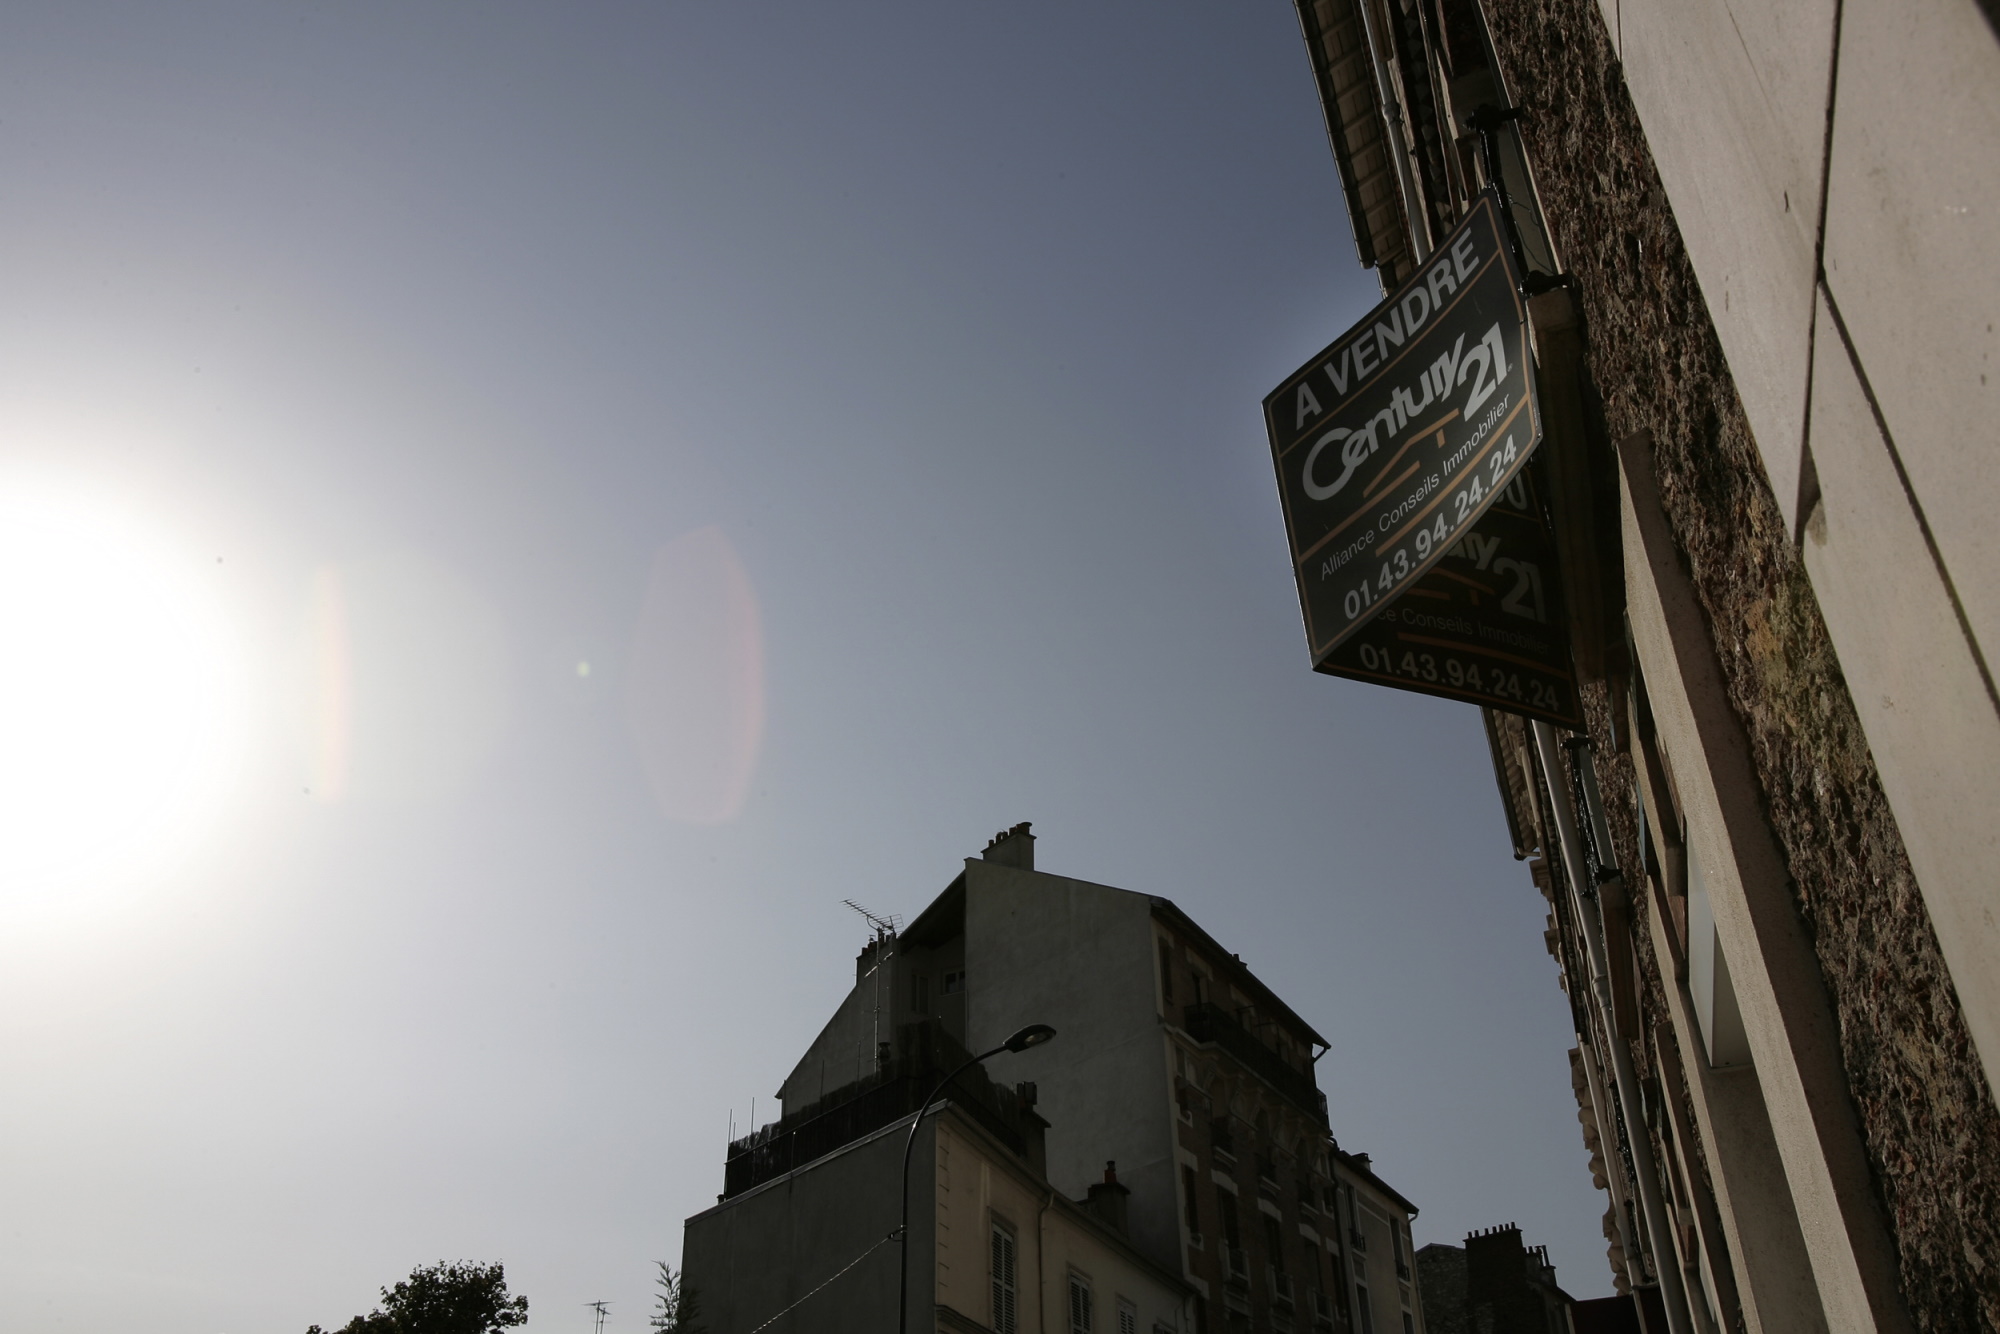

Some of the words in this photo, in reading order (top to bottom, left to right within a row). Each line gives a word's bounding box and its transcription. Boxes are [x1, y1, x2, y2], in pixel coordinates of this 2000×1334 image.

[1296, 381, 1323, 431] A
[1324, 227, 1480, 397] VENDRE
[1302, 332, 1466, 501] Century
[1457, 321, 1508, 422] 21
[1321, 528, 1375, 581] Alliance
[1378, 472, 1440, 533] Conseils
[1443, 393, 1510, 477] Immobilier
[1343, 433, 1517, 621] 01.43.94.24.24
[1359, 642, 1560, 713] 01.43.94.24.24
[1401, 607, 1473, 636] Conseils
[1478, 621, 1550, 656] Immobilier
[1493, 556, 1547, 625] 21
